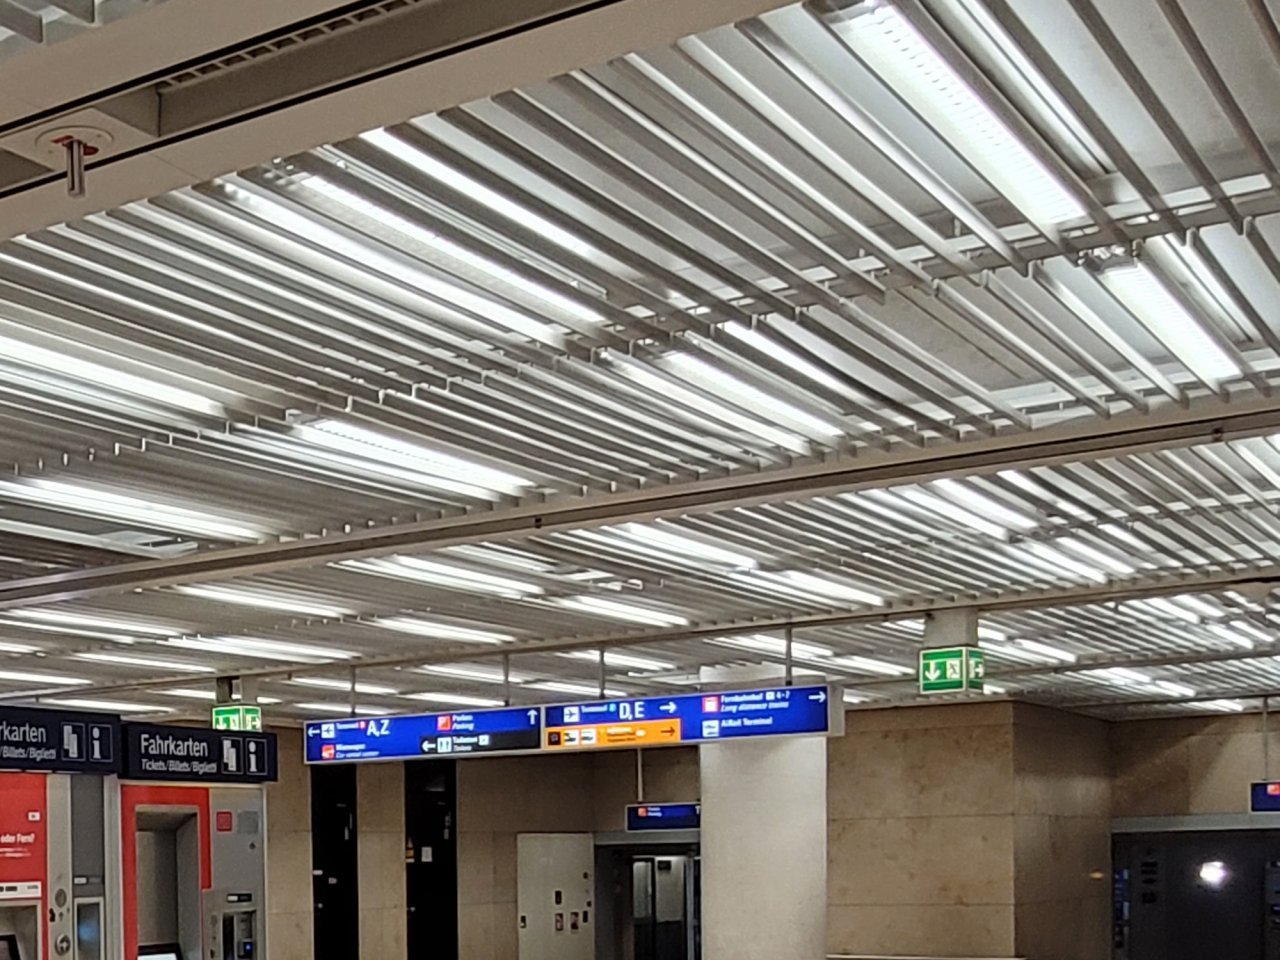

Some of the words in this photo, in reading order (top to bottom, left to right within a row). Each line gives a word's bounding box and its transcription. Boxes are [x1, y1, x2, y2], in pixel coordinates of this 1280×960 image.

[619, 702, 645, 720] D,E
[366, 719, 391, 737] A,Z
[140, 734, 208, 757] Fahrkarten
